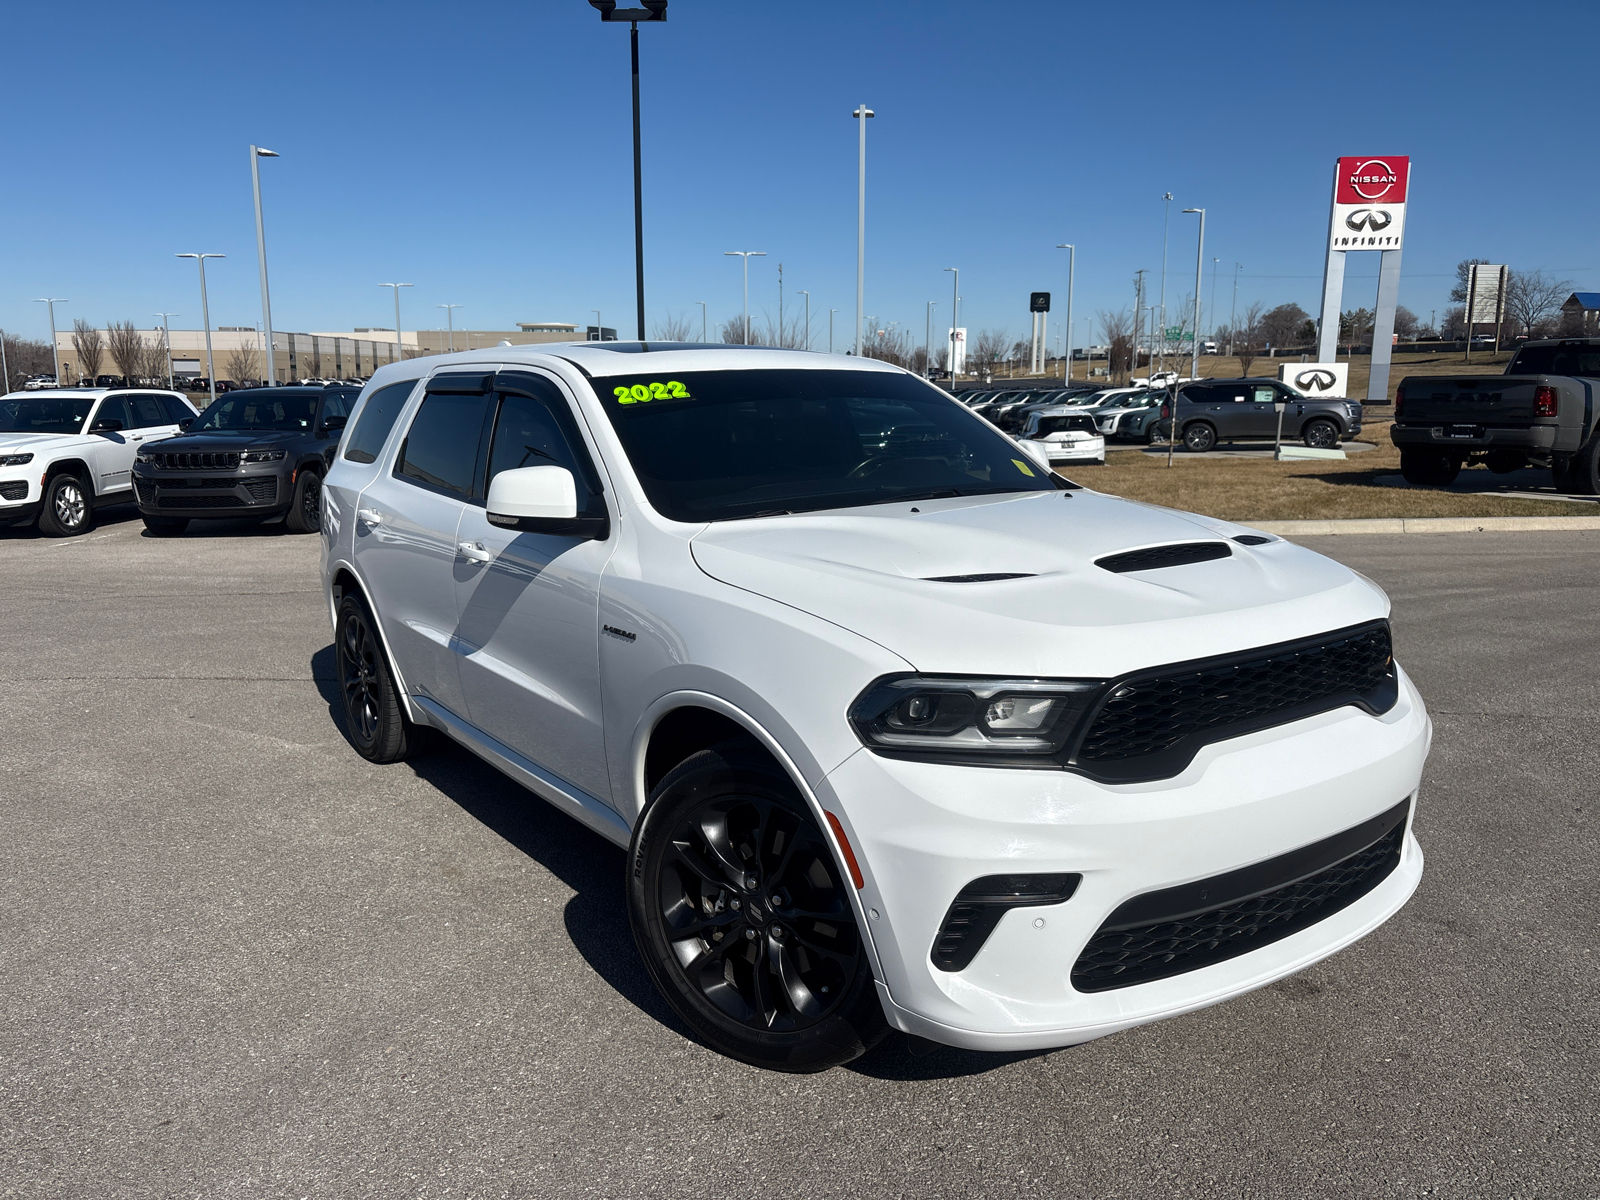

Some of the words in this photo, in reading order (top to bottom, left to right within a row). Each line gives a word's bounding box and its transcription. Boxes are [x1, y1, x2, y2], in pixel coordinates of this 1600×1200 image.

[1334, 237, 1399, 246] INFINITI
[613, 381, 691, 405] 2022
[1431, 392, 1503, 402] RAM
[603, 624, 637, 641] HEMI
[634, 827, 651, 879] ROVELO
